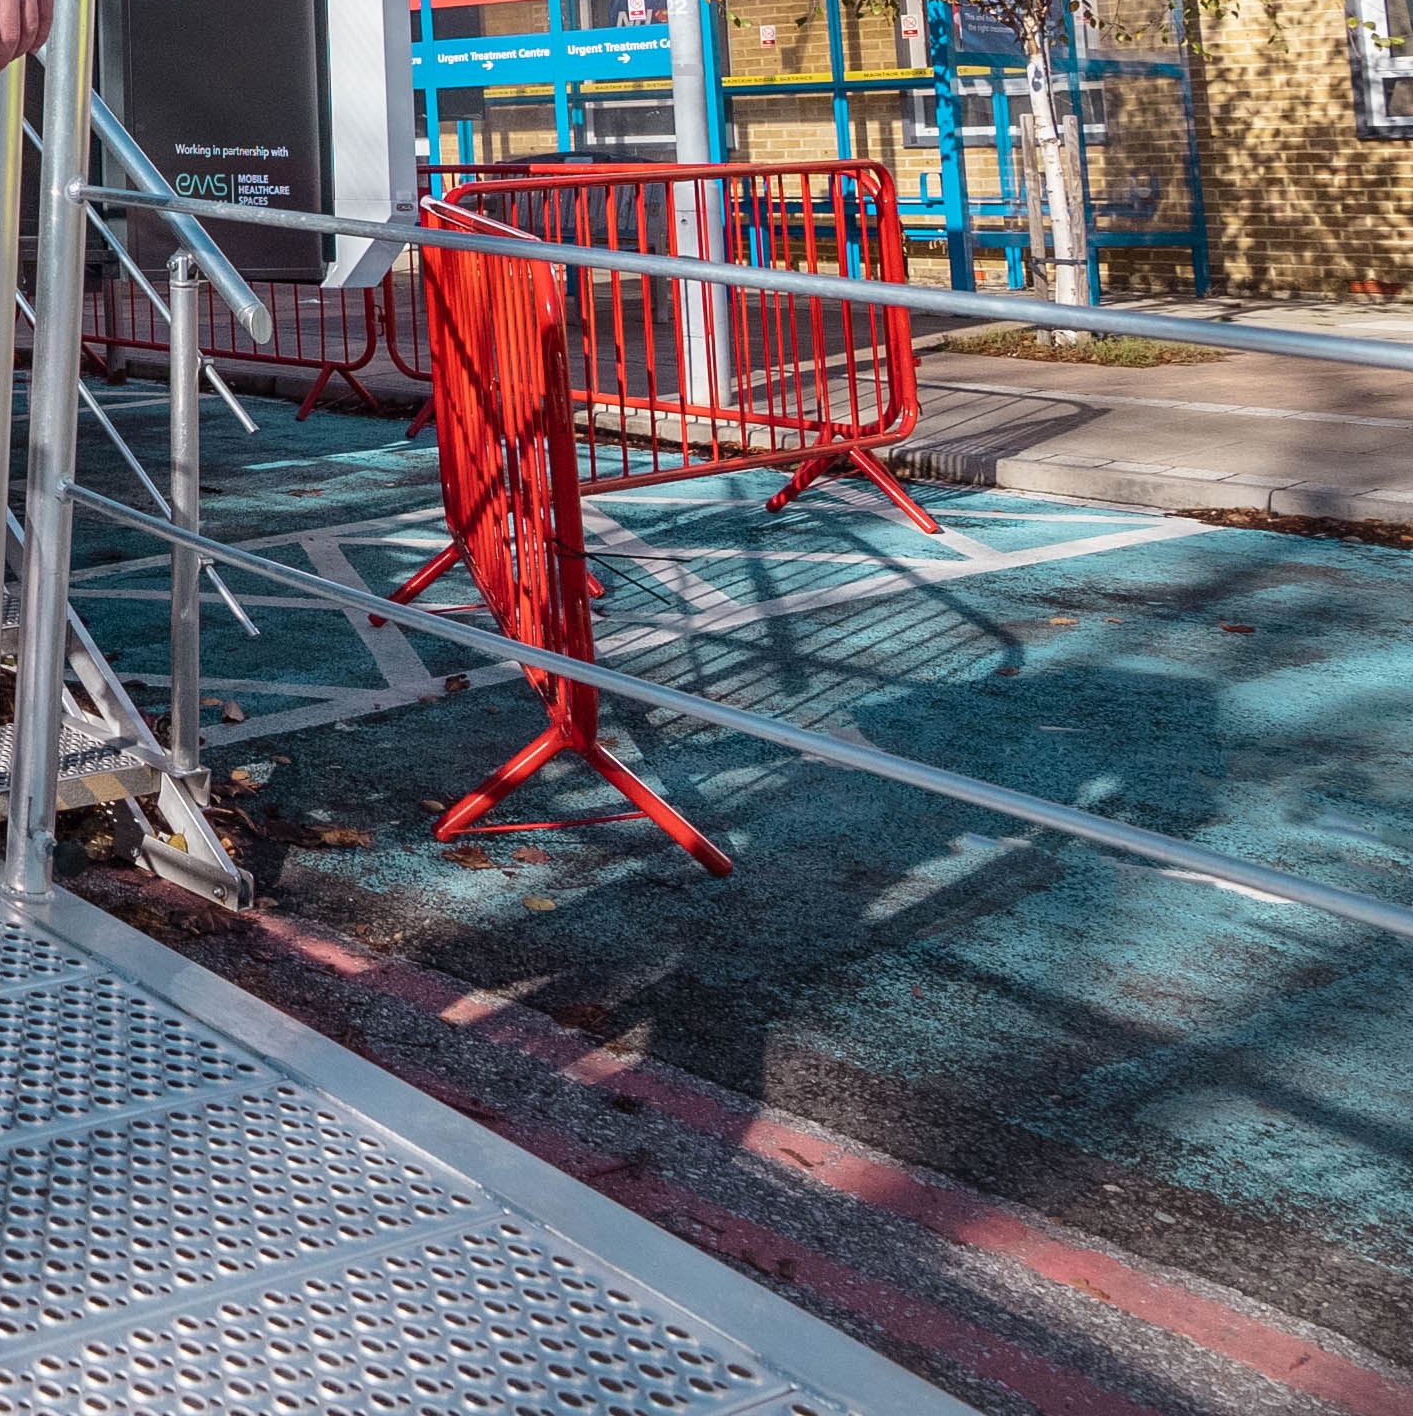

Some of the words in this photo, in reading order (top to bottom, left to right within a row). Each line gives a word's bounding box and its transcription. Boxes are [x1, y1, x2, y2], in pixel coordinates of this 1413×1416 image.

[567, 43, 603, 57] Urgent
[604, 38, 658, 52] Treatment
[437, 52, 469, 65] Urgent
[470, 49, 517, 62] Treatment
[518, 47, 551, 58] Centre
[175, 143, 211, 158] Working
[213, 144, 221, 156] in
[222, 145, 270, 160] partnership
[271, 146, 289, 158] with
[237, 173, 269, 184] MOBILE
[238, 185, 290, 195] HEALTHCARE
[238, 195, 269, 206] SPACES
